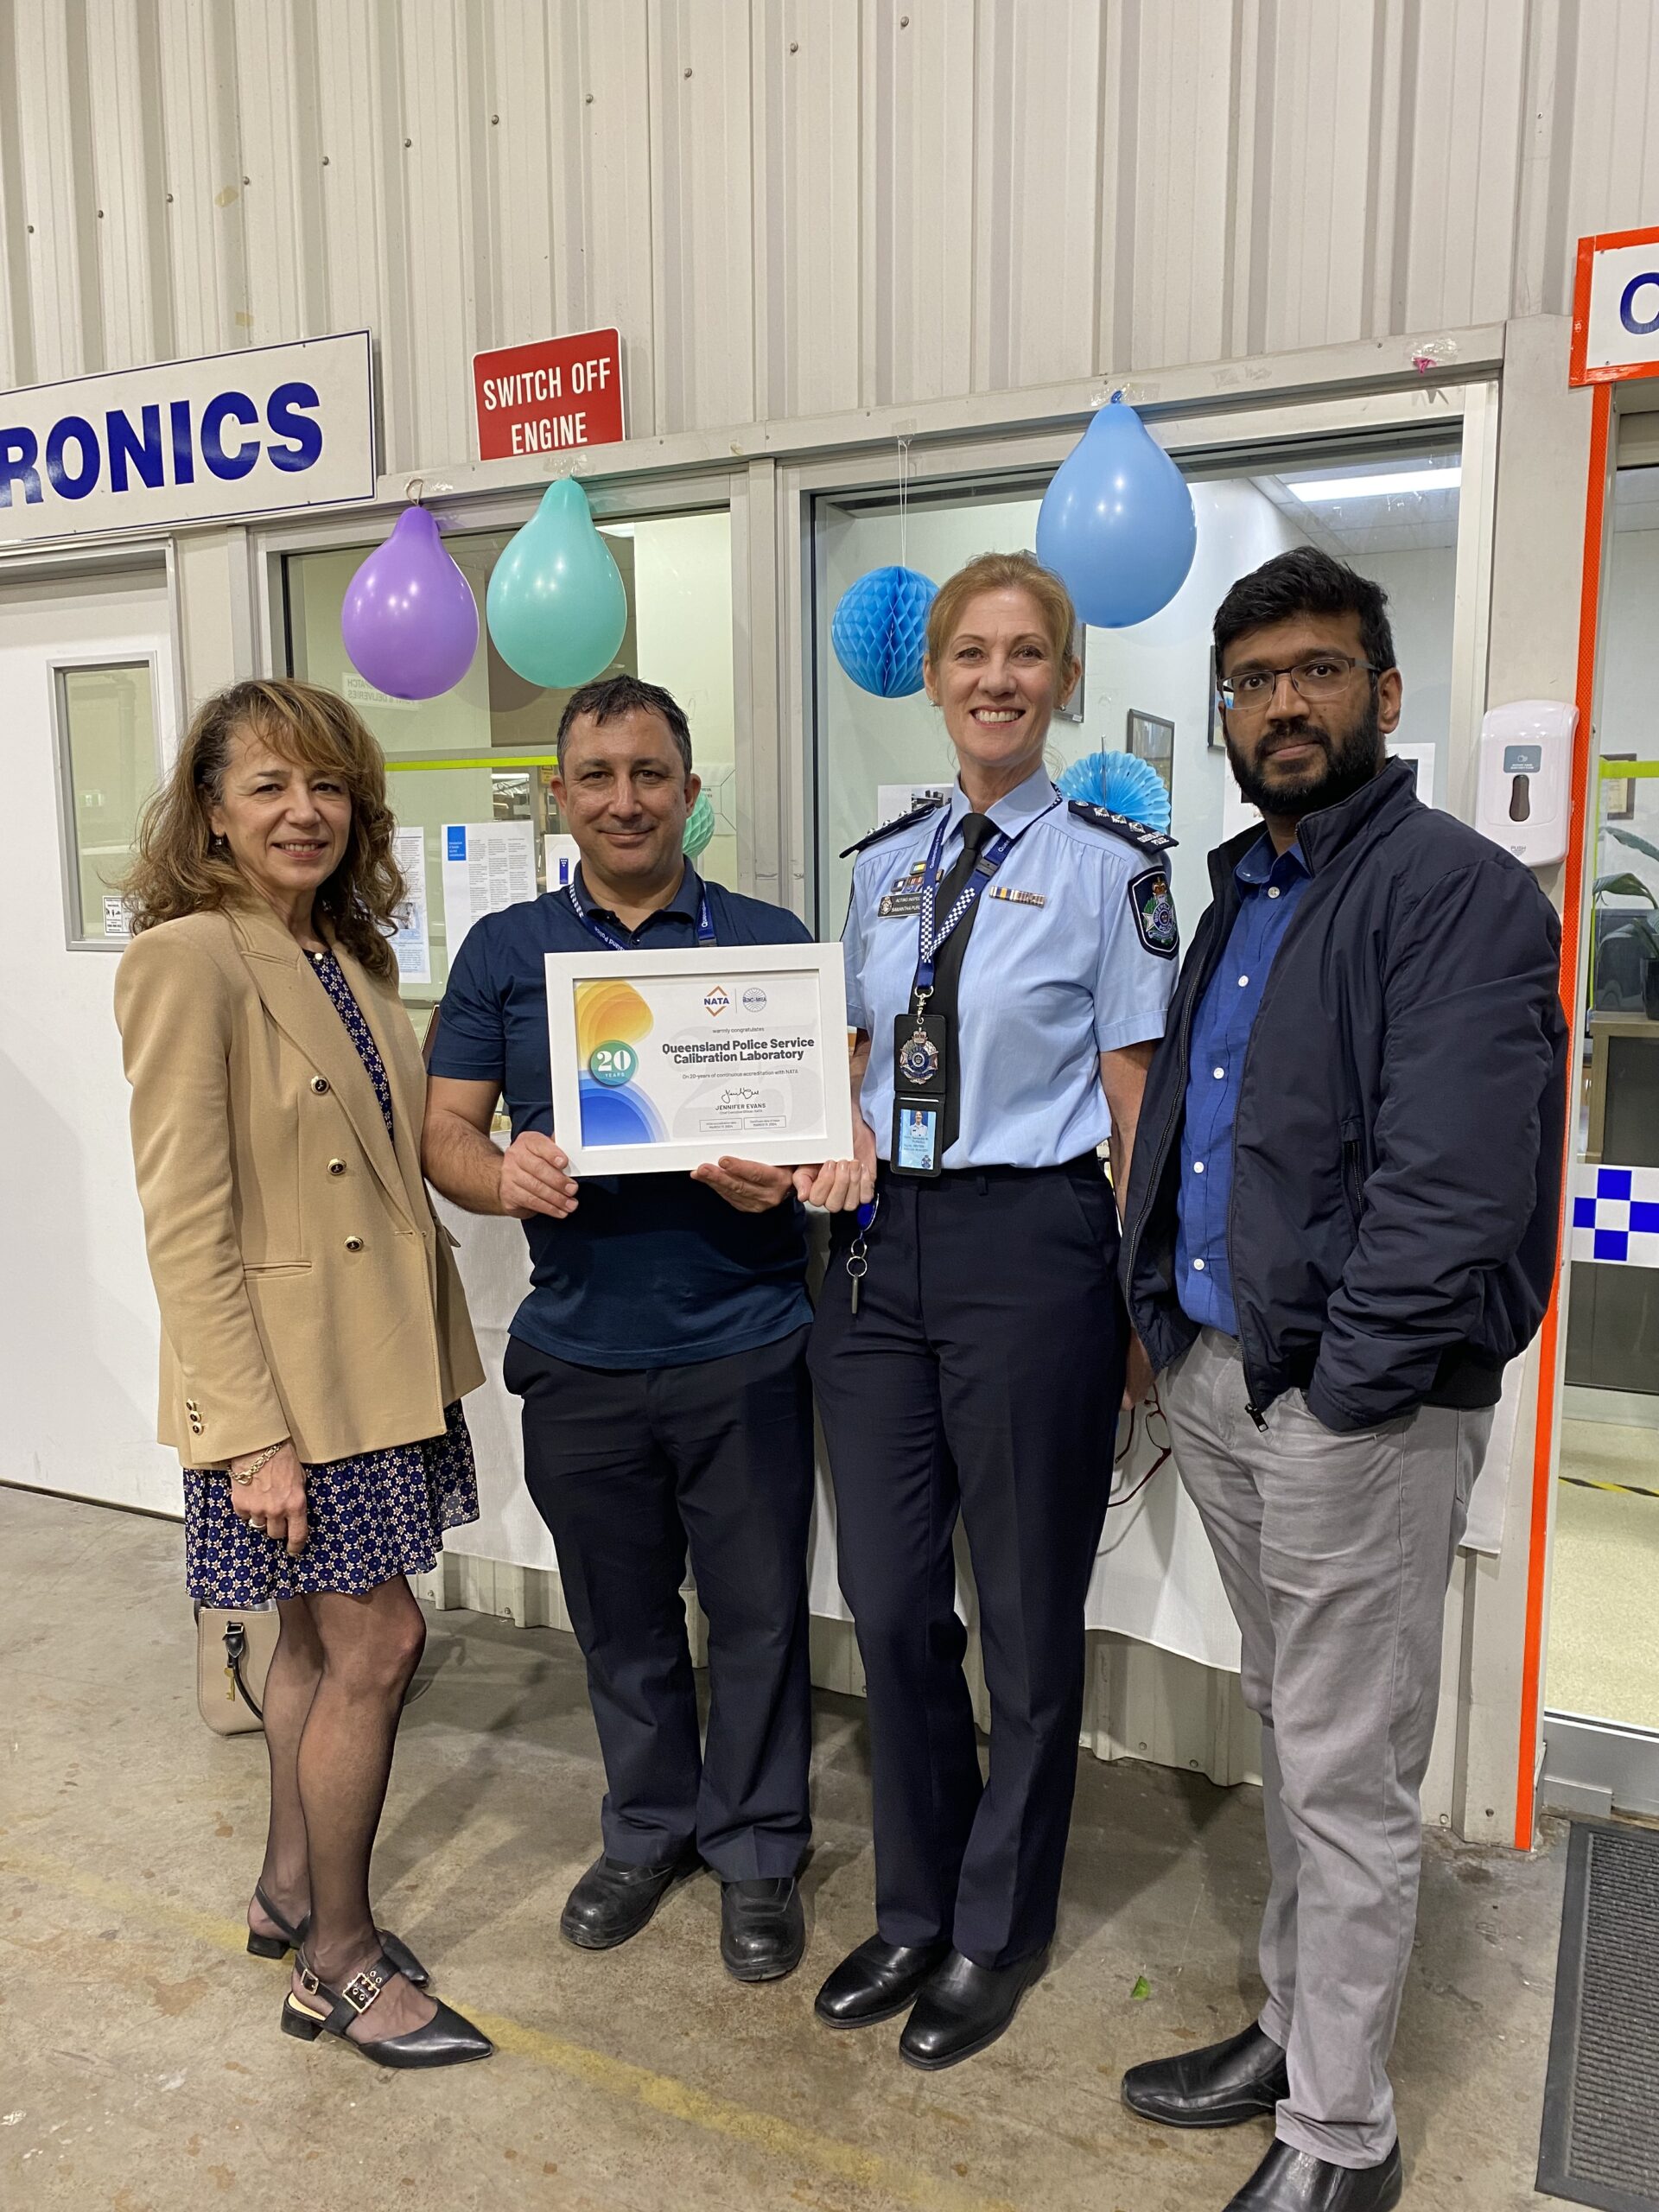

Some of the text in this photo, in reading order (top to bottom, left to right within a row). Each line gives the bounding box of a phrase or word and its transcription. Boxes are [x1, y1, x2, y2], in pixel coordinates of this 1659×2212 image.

[483, 357, 611, 410] SWITCH OFF
[511, 411, 588, 454] ENGINE
[0, 382, 323, 508] RONICS
[703, 997, 730, 1006] NATA
[662, 1037, 815, 1054] Queensland Police Service
[596, 1049, 632, 1071] 20
[674, 1049, 804, 1065] Calibration Laboratory
